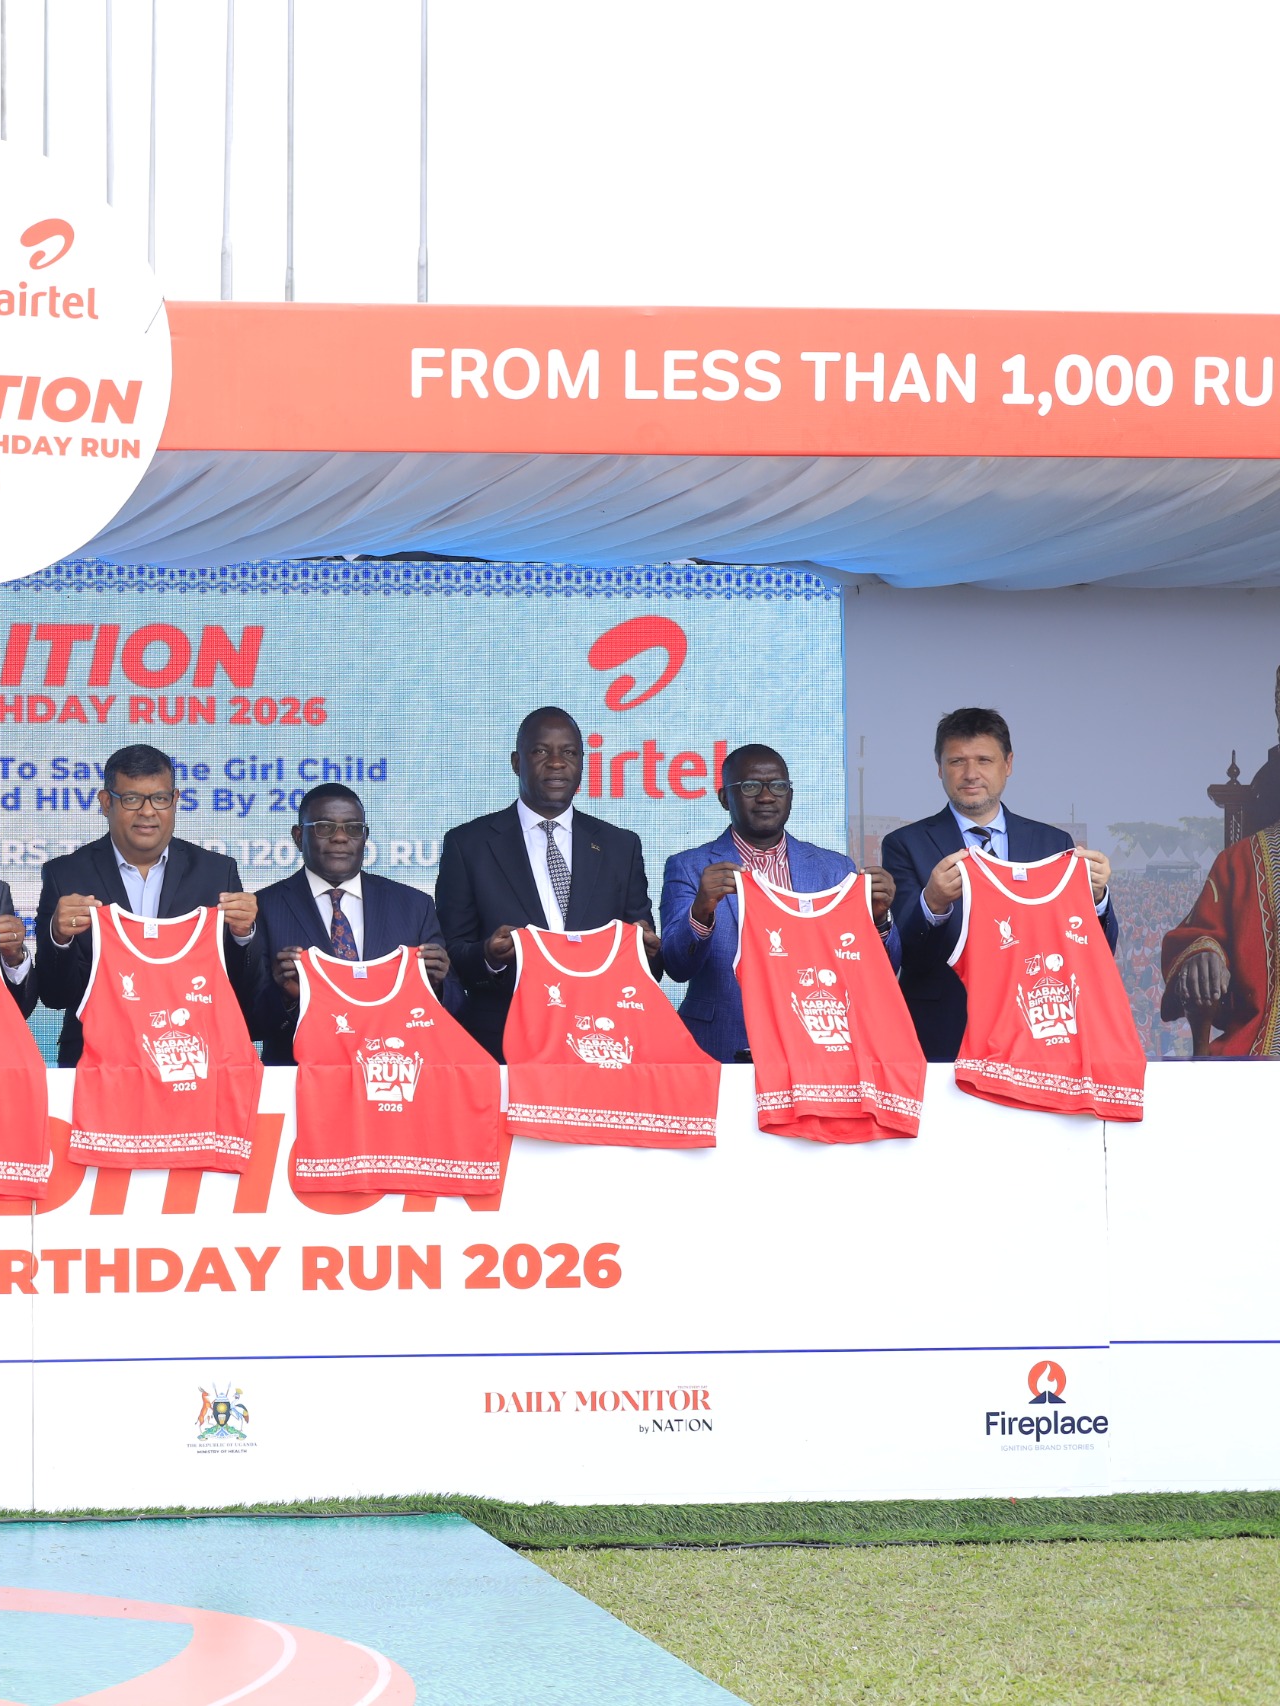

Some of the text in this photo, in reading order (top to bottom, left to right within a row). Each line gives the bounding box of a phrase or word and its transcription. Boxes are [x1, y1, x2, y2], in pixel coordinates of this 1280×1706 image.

[411, 347, 1275, 416] FROM LESS THAN 1,000 RU
[80, 437, 141, 459] RUN
[128, 695, 216, 725] RUN
[227, 695, 328, 726] 2026
[51, 757, 104, 780] Sav
[171, 756, 210, 780] he
[224, 755, 284, 780] Girl
[297, 756, 388, 781] Child
[577, 733, 728, 800] irtel
[213, 787, 255, 818] By
[270, 788, 305, 812] 20
[1065, 930, 1088, 945] airtel
[185, 992, 212, 1004] airtel
[1027, 985, 1070, 1000] KABAKA
[616, 1000, 645, 1011] airtel
[801, 1000, 846, 1009] KABAKA
[1029, 994, 1070, 1008] BIRTHDAY
[803, 1008, 847, 1016] BIRTHDAY
[1029, 1003, 1074, 1022] RUN
[406, 1019, 435, 1029] airtel
[805, 1015, 850, 1031] RUN
[153, 1036, 199, 1048] KABAKA
[1045, 1036, 1070, 1047] 2026
[155, 1050, 204, 1066] RUN
[368, 1063, 415, 1082] RUN
[172, 1081, 197, 1092] 2026
[378, 1103, 403, 1112] 2026
[302, 1245, 442, 1291] RUN
[464, 1242, 622, 1290] 2026
[484, 1389, 712, 1413] DAILY MONITOR
[639, 1418, 713, 1434] by NATION
[986, 1411, 1108, 1442] Fireplace
